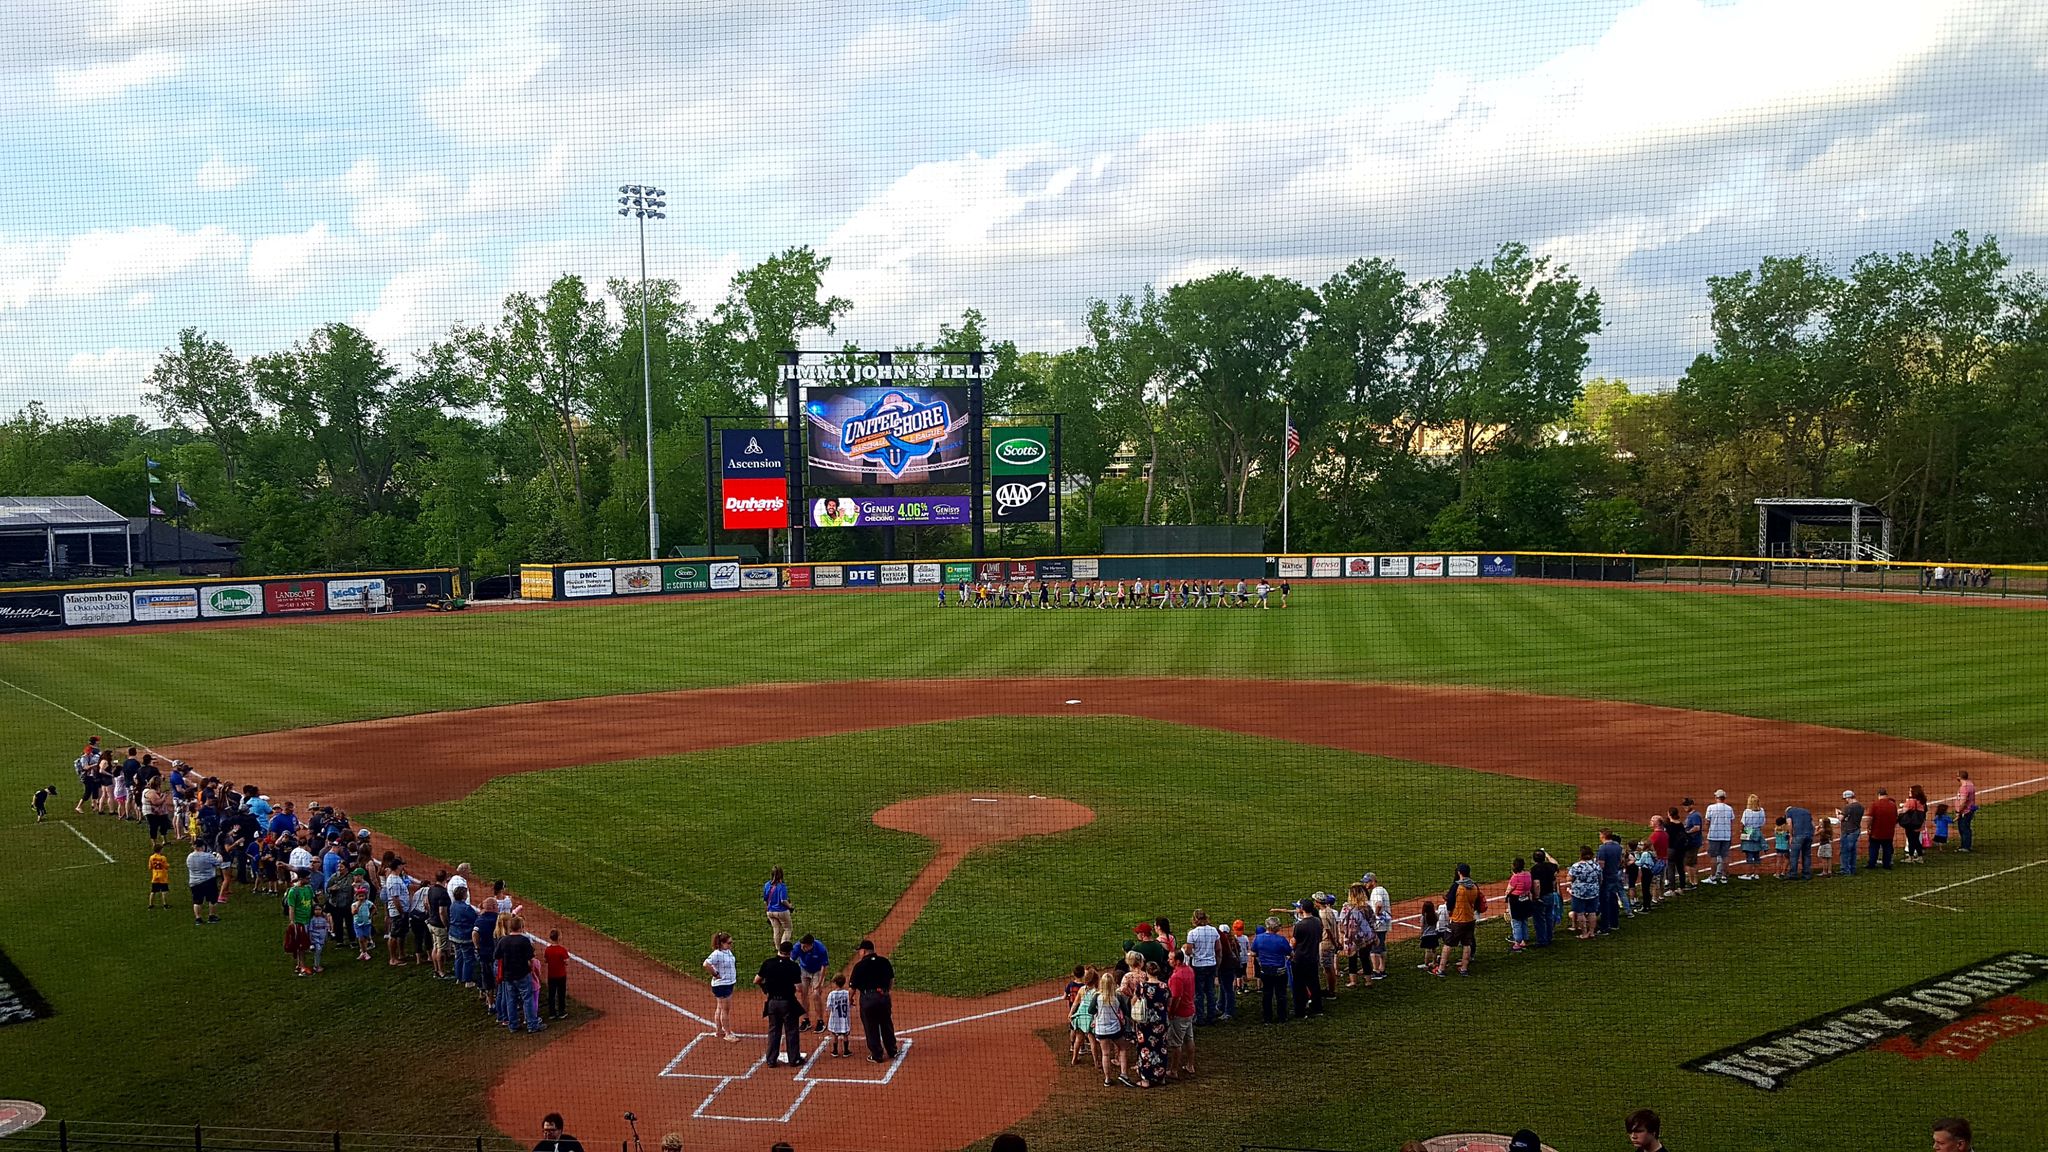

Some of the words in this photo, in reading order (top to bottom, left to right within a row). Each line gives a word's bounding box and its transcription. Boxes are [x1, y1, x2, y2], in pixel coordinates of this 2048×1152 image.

[777, 364, 850, 383] JIMMY
[854, 364, 927, 383] JOHN'S
[928, 364, 995, 380] FIELD
[845, 411, 900, 444] UNITED
[893, 406, 944, 437] SHORE
[909, 429, 942, 442] LEAGUE
[727, 458, 782, 469] Ascension
[1000, 484, 1028, 507] AAA
[725, 496, 785, 510] Dunham's
[863, 502, 895, 513] GENIUS
[749, 571, 769, 579] Ford
[849, 570, 875, 580] DTE
[673, 581, 692, 589] SCOTTS
[66, 594, 104, 604] Macomb
[105, 593, 128, 603] Daily
[274, 588, 316, 599] LANDSCAPE
[213, 591, 251, 609] Hollywood
[835, 1003, 848, 1018] 19
